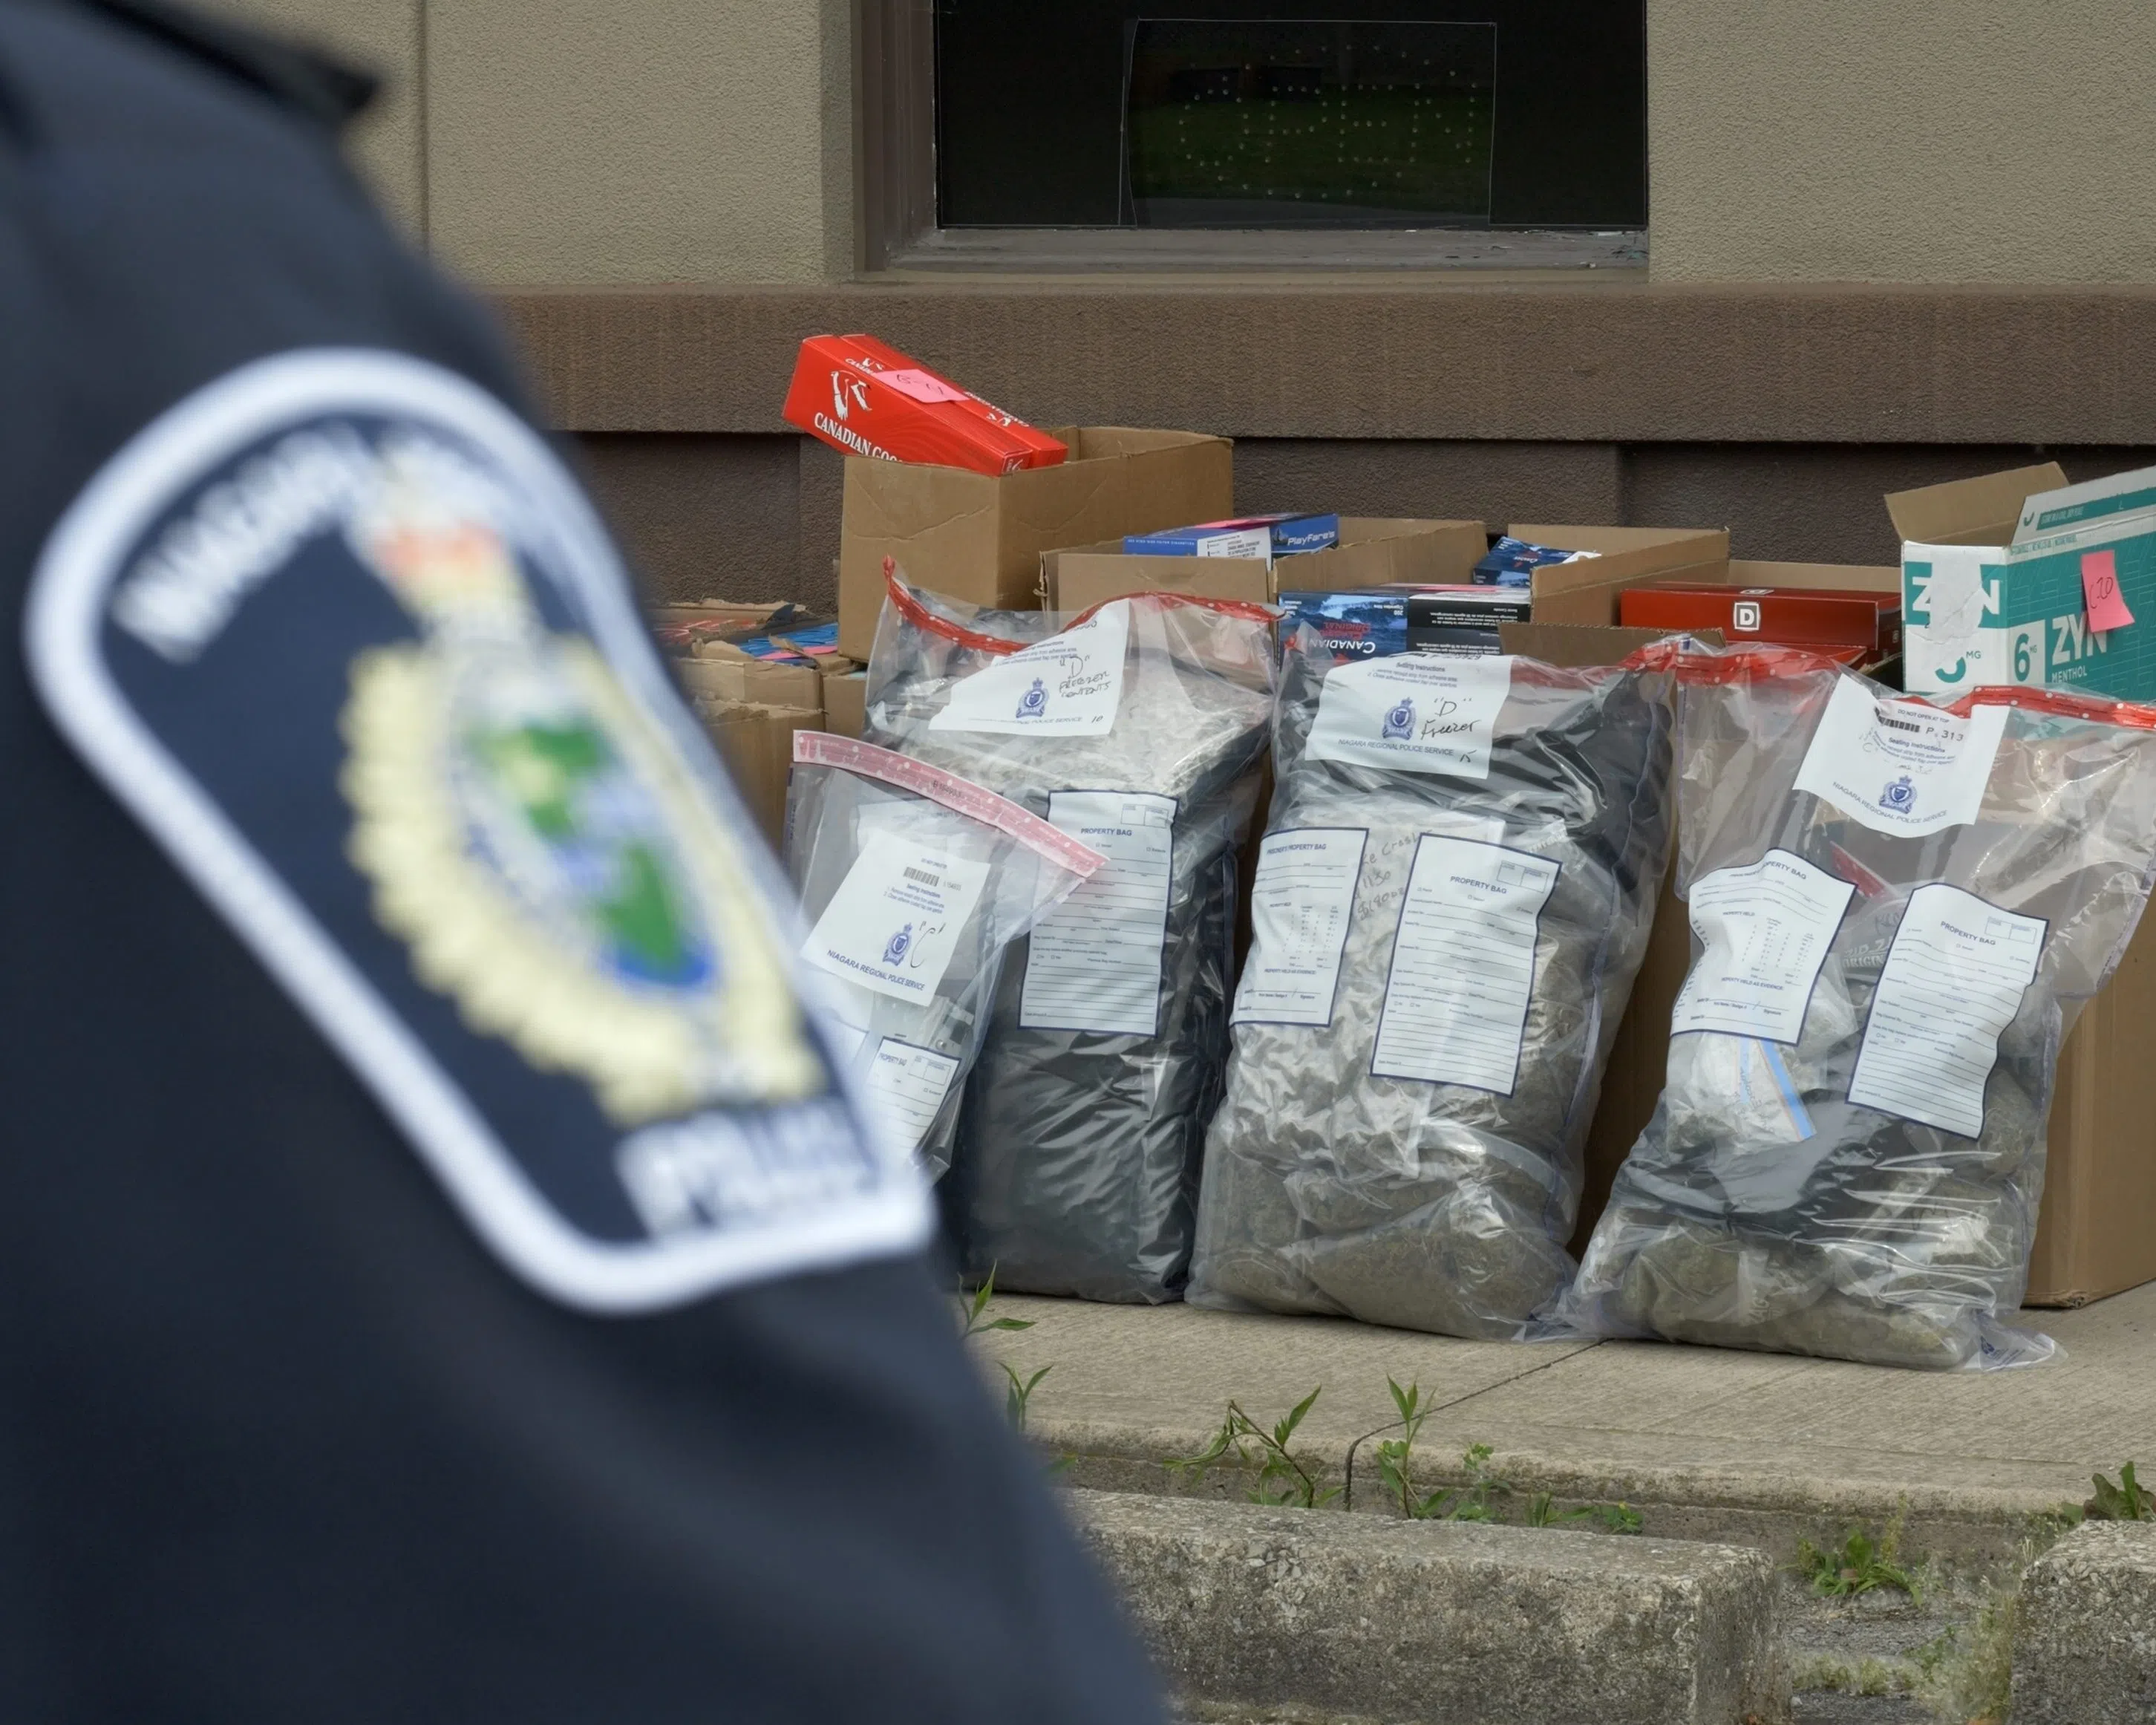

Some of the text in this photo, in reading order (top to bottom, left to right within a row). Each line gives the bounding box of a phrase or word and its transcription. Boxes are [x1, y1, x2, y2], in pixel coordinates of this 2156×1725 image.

[814, 412, 872, 456] CANADIAN
[1740, 608, 1755, 625] D
[1308, 639, 1376, 653] CANADIAN
[1966, 650, 1982, 659] MG
[2014, 633, 2031, 682] 6
[2051, 665, 2088, 683] MENTHOL
[1339, 739, 1454, 757] NIAGARA REGIONAL POLICE SERVICE
[1889, 737, 1910, 748] Sealing
[1832, 781, 1861, 803] NIAGARA
[1861, 800, 1895, 821] REGIONAL
[1895, 815, 1921, 824] POLICE
[1080, 827, 1133, 836] PROPERTY BAG
[1791, 868, 1807, 881] BAG
[1450, 875, 1508, 895] PROPERTY BAG
[1940, 920, 1997, 946] PROPERTY BAG
[827, 949, 926, 991] NIAGARA REGIONAL POLICE SERVICE
